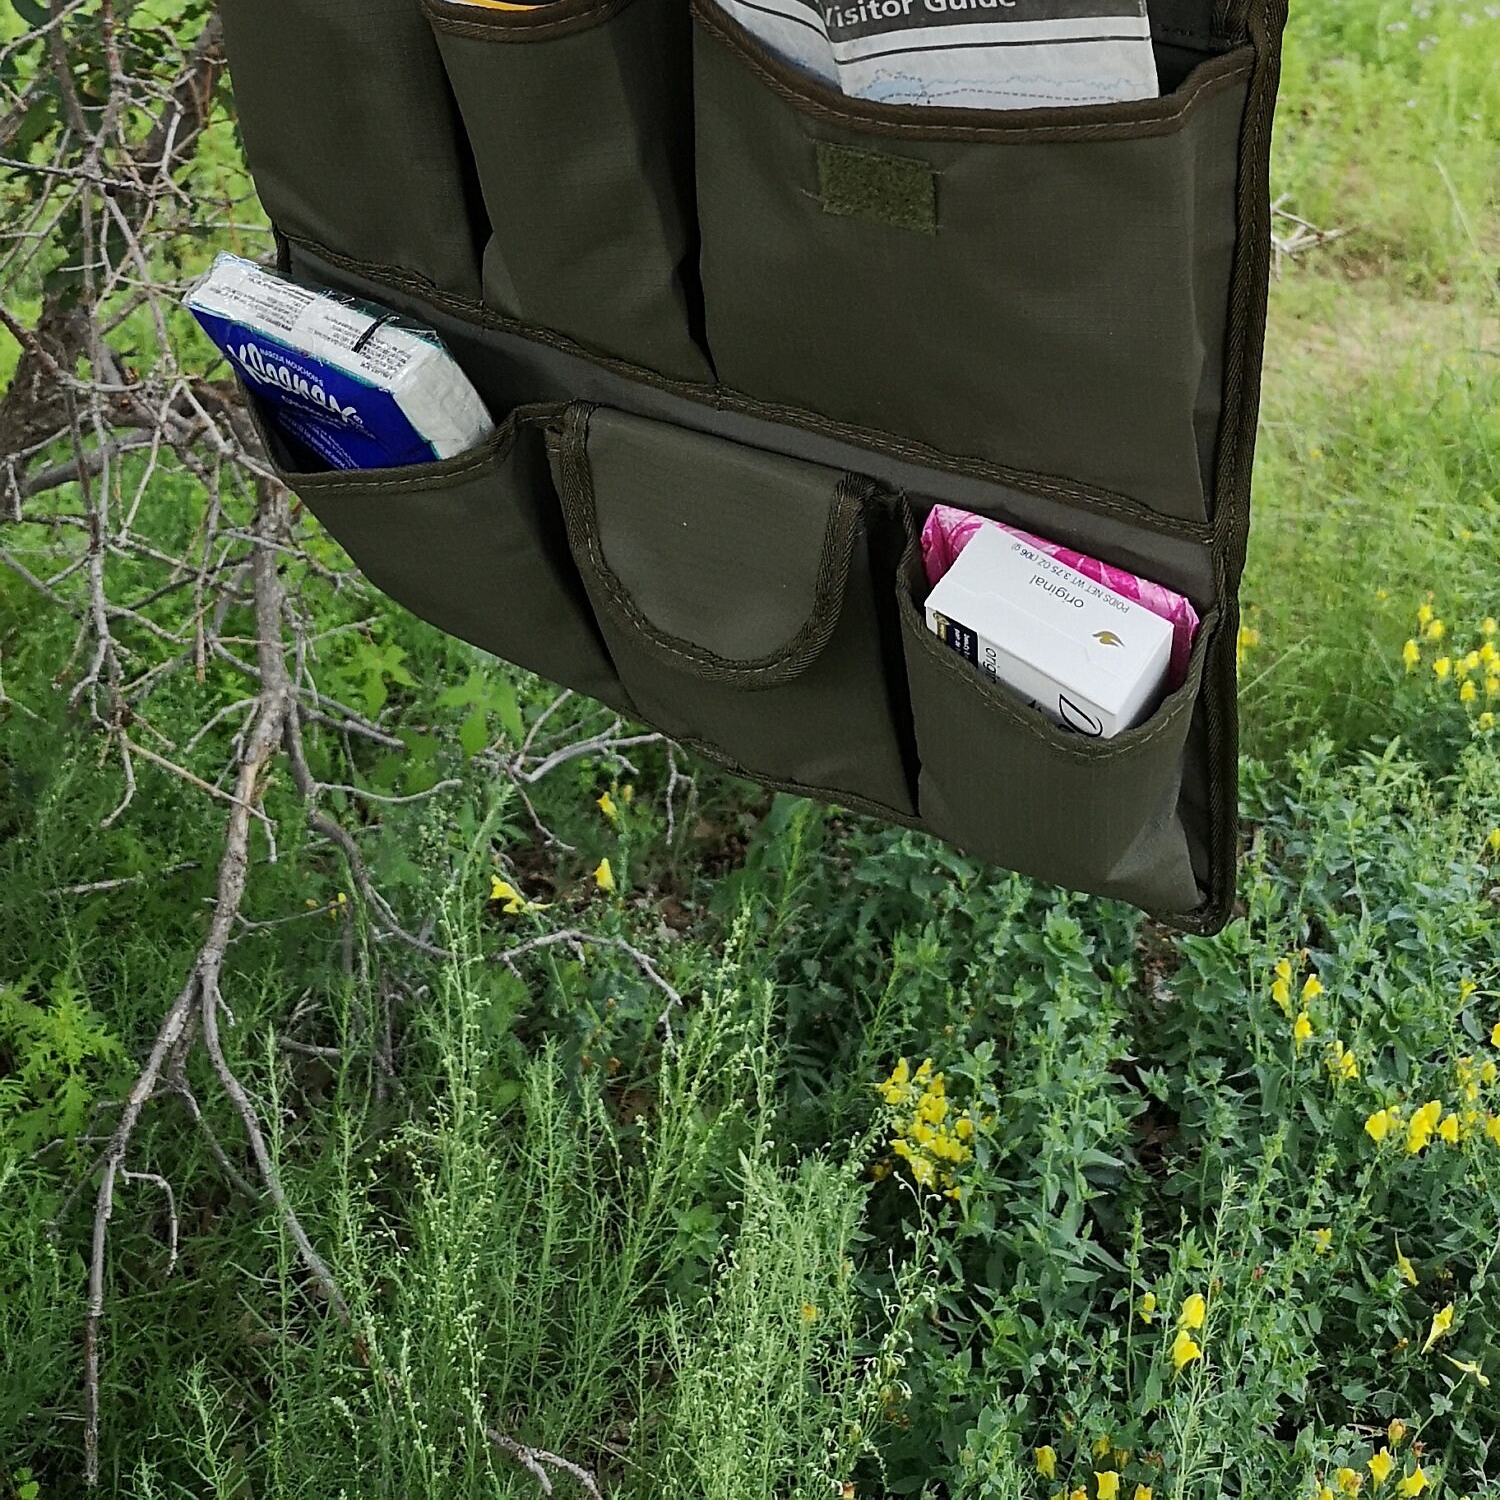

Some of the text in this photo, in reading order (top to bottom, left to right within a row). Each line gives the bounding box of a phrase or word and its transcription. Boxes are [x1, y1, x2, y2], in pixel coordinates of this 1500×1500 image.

[1038, 559, 1051, 569] OZ
[1051, 565, 1071, 580] 3.75
[1071, 577, 1085, 588] WT
[1029, 574, 1084, 608] original
[1084, 585, 1103, 598] NET
[1103, 594, 1130, 613] POIDS
